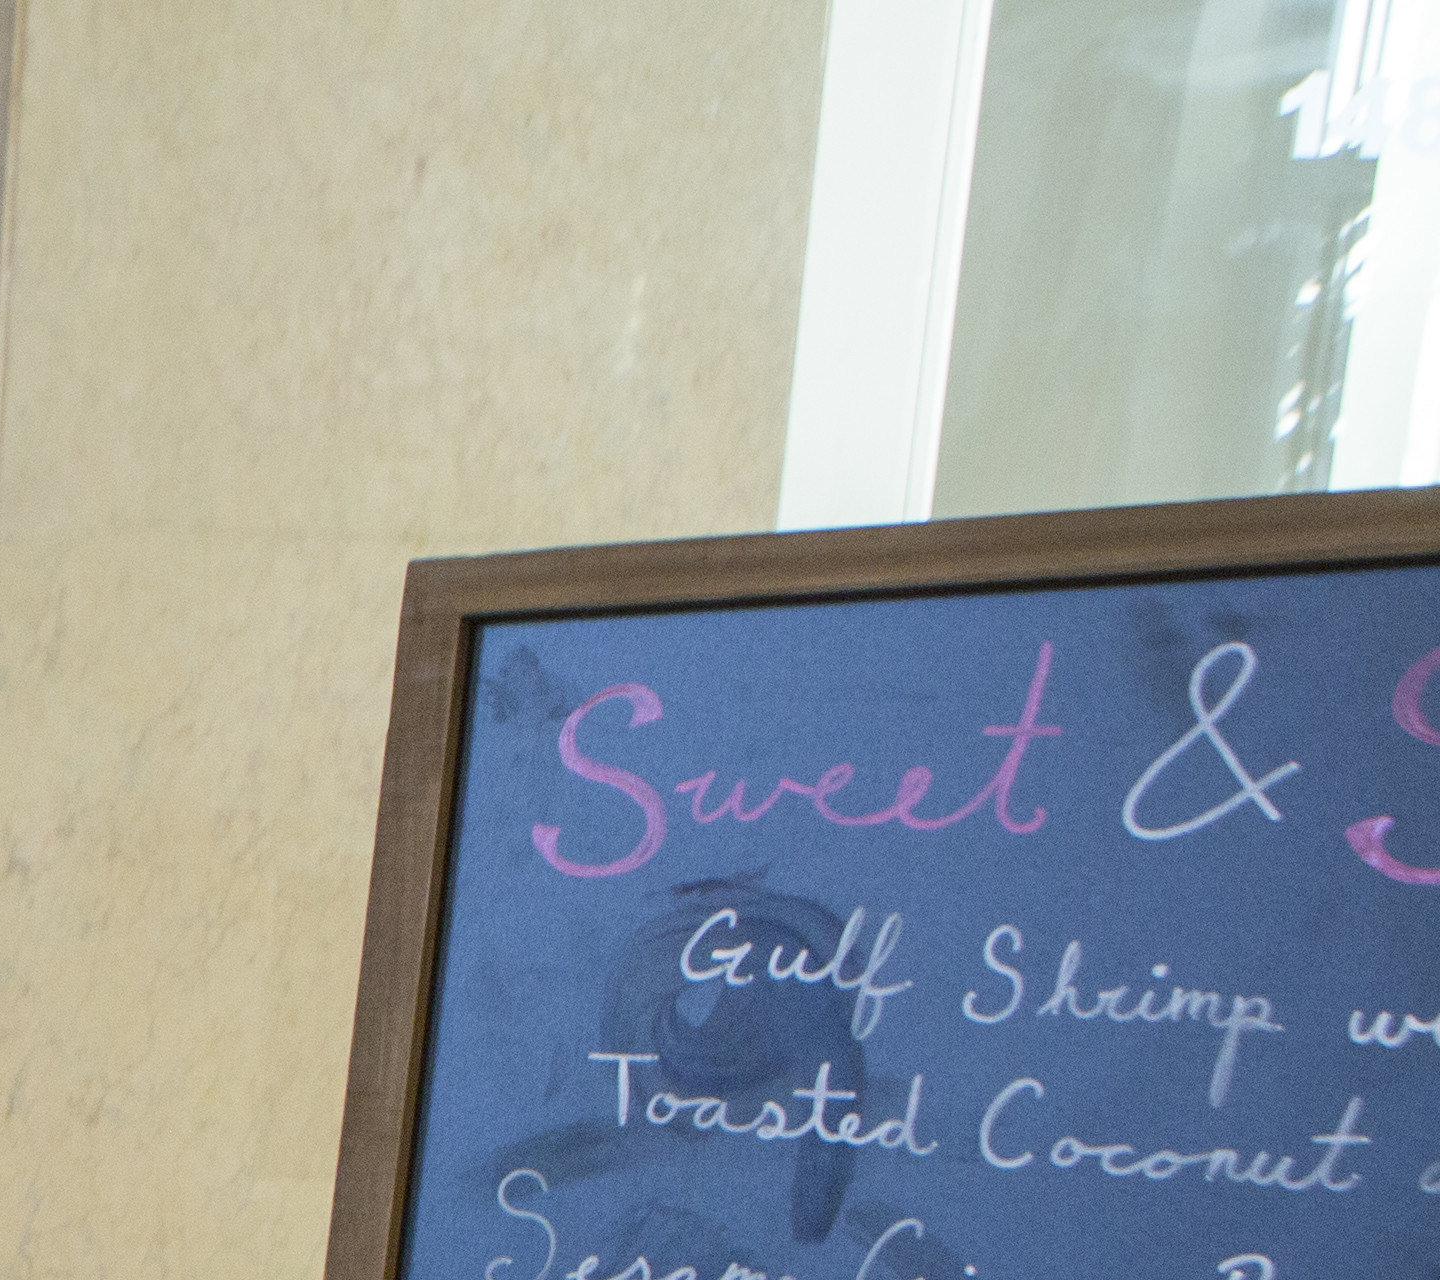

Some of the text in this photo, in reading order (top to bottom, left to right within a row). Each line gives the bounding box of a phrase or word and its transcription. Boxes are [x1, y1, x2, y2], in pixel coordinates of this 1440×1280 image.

[532, 642, 1063, 878] Sweet
[1122, 642, 1300, 840] &
[680, 907, 1284, 1107] Gulf Shrimp
[587, 1051, 1370, 1194] Toasted Coconut
